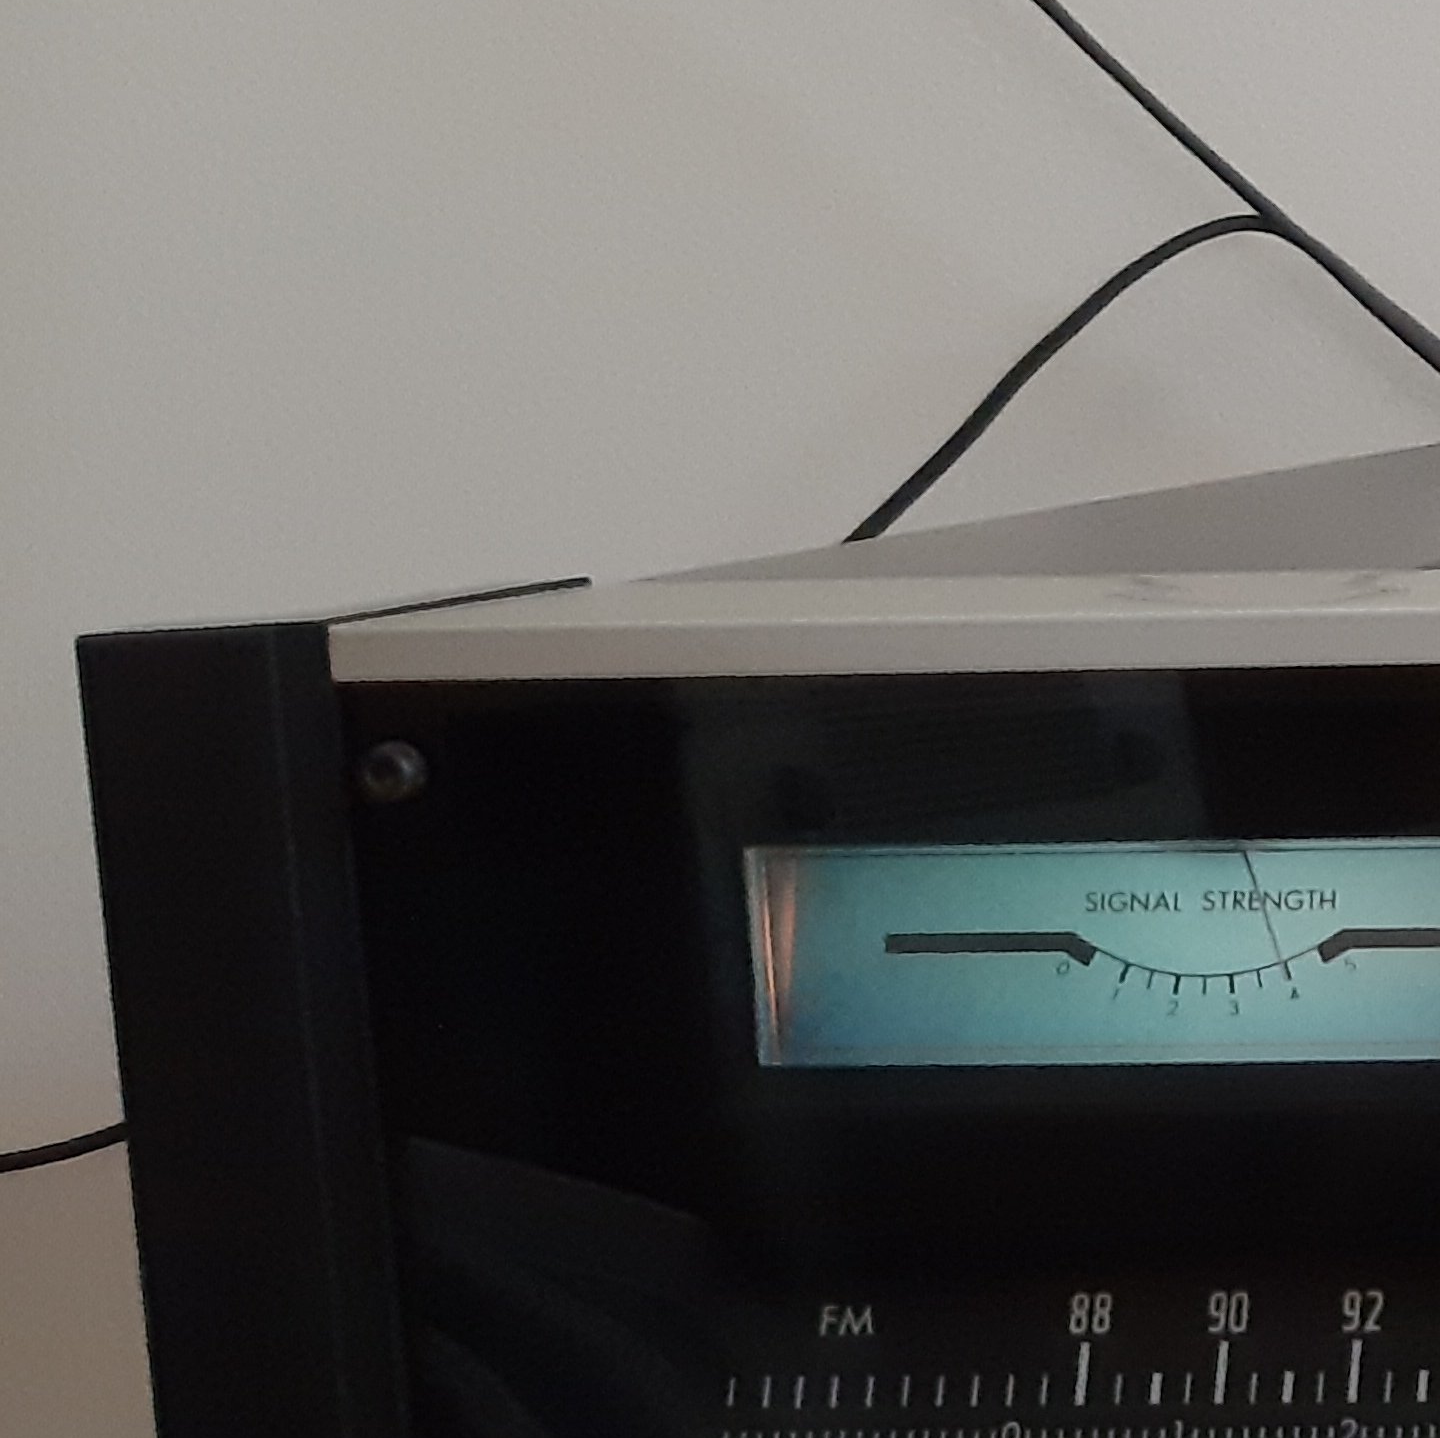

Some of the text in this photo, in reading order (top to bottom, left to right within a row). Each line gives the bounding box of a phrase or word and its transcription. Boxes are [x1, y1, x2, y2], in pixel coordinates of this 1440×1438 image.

[1085, 889, 1337, 913] SIGNAL STRENGTH
[1165, 999, 1180, 1017] 2
[819, 1305, 874, 1336] FM
[1068, 1293, 1112, 1335] 88
[1208, 1291, 1249, 1334] 90
[1342, 1290, 1384, 1333] 92
